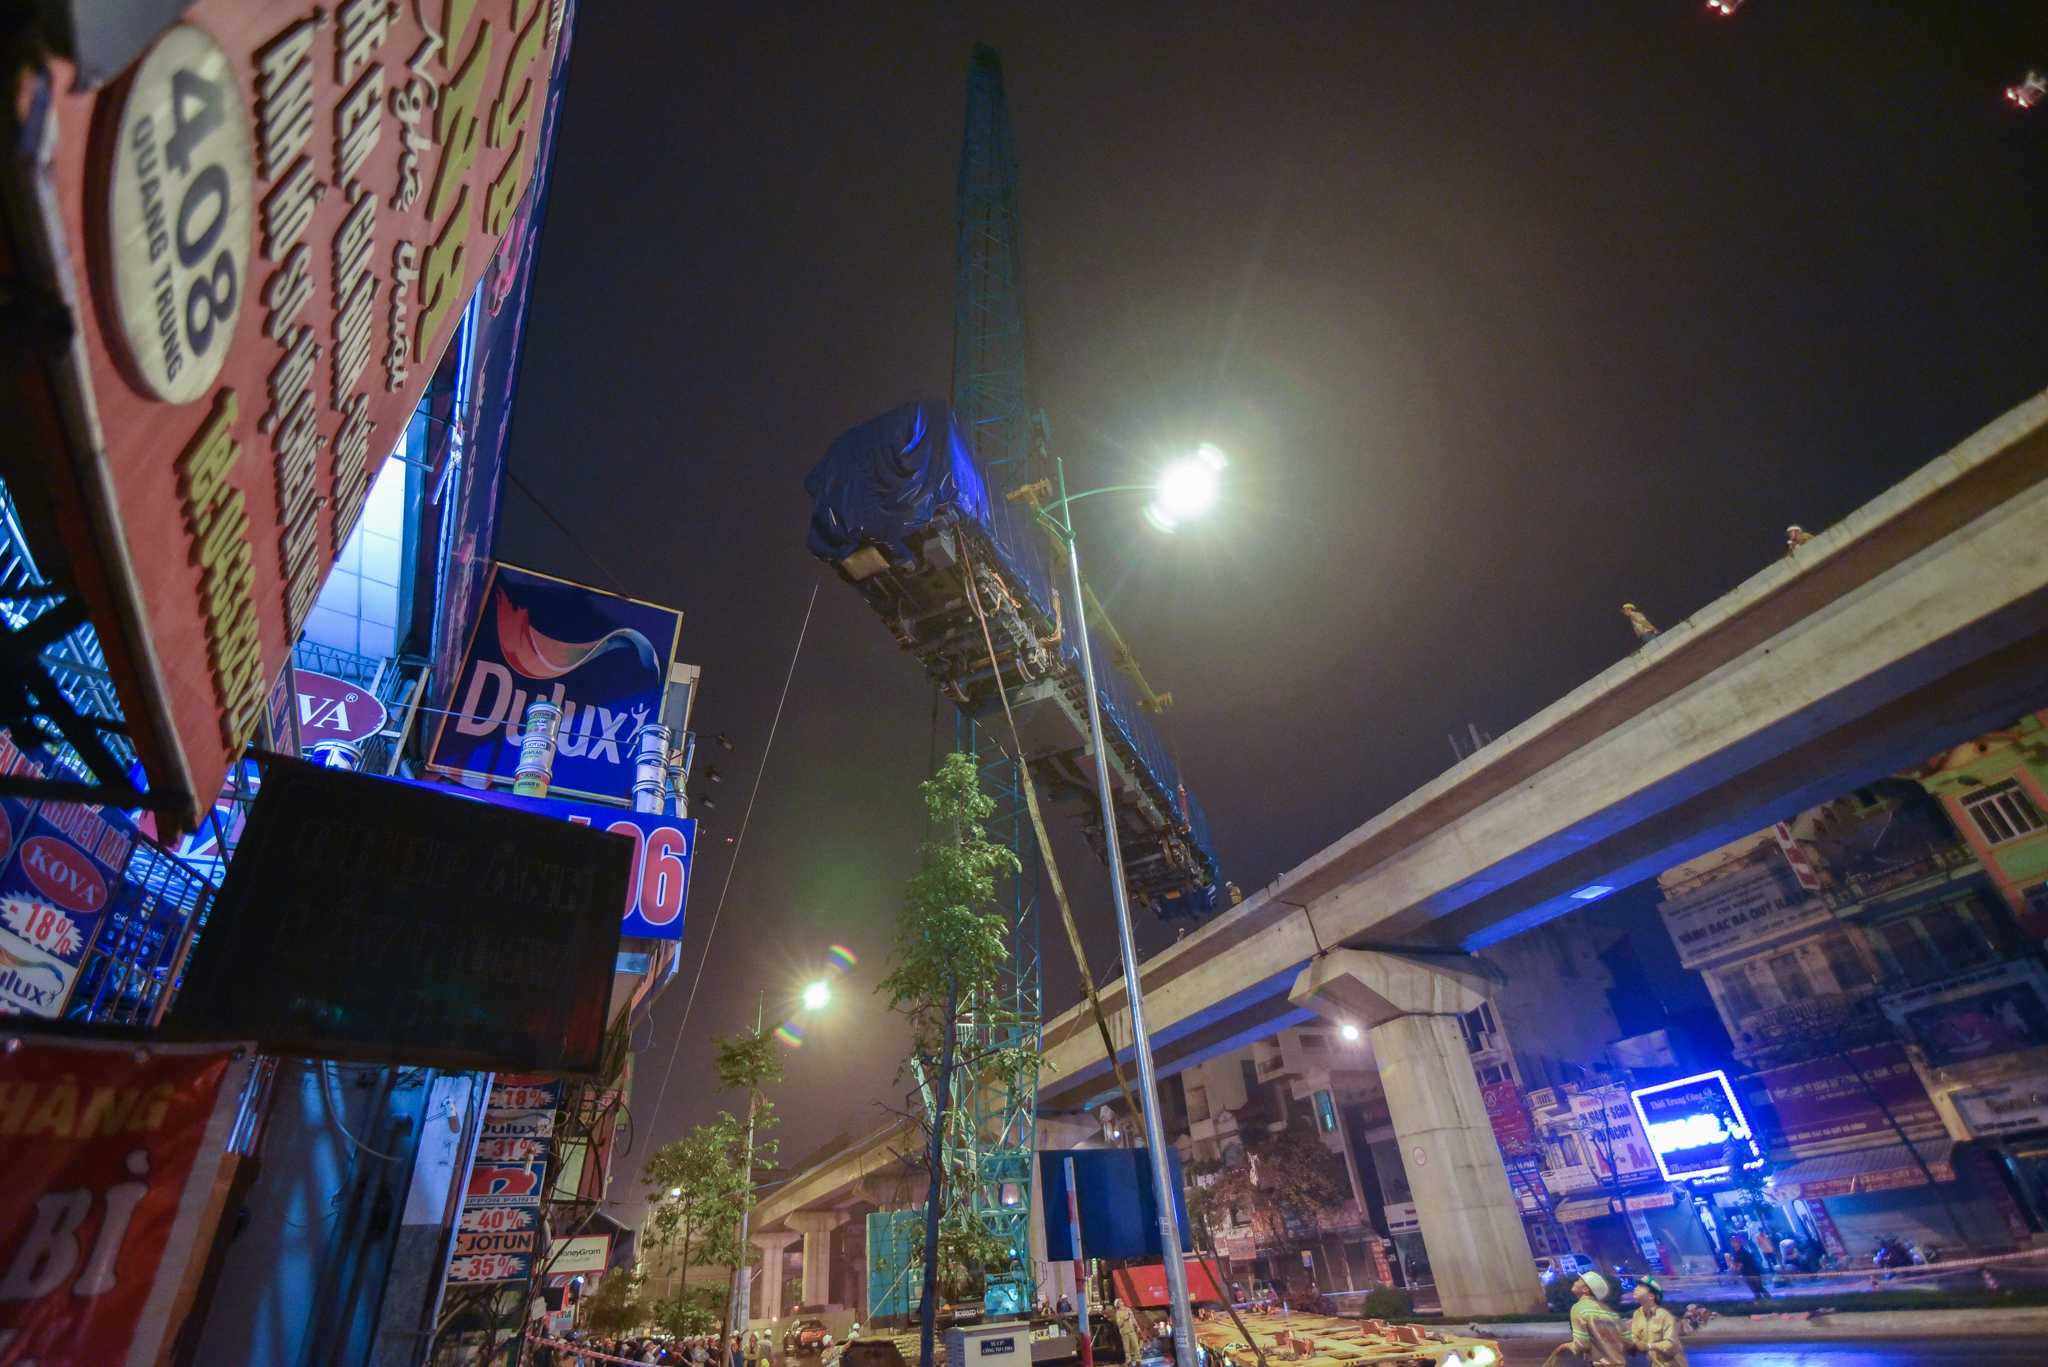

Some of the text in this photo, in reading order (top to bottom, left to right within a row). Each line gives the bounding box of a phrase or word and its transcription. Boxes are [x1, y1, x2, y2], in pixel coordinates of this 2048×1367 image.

[130, 114, 183, 384] QUANG TRUNG
[164, 66, 238, 358] 408
[29, 846, 96, 906] KOVA
[466, 1234, 532, 1251] JOTUN
